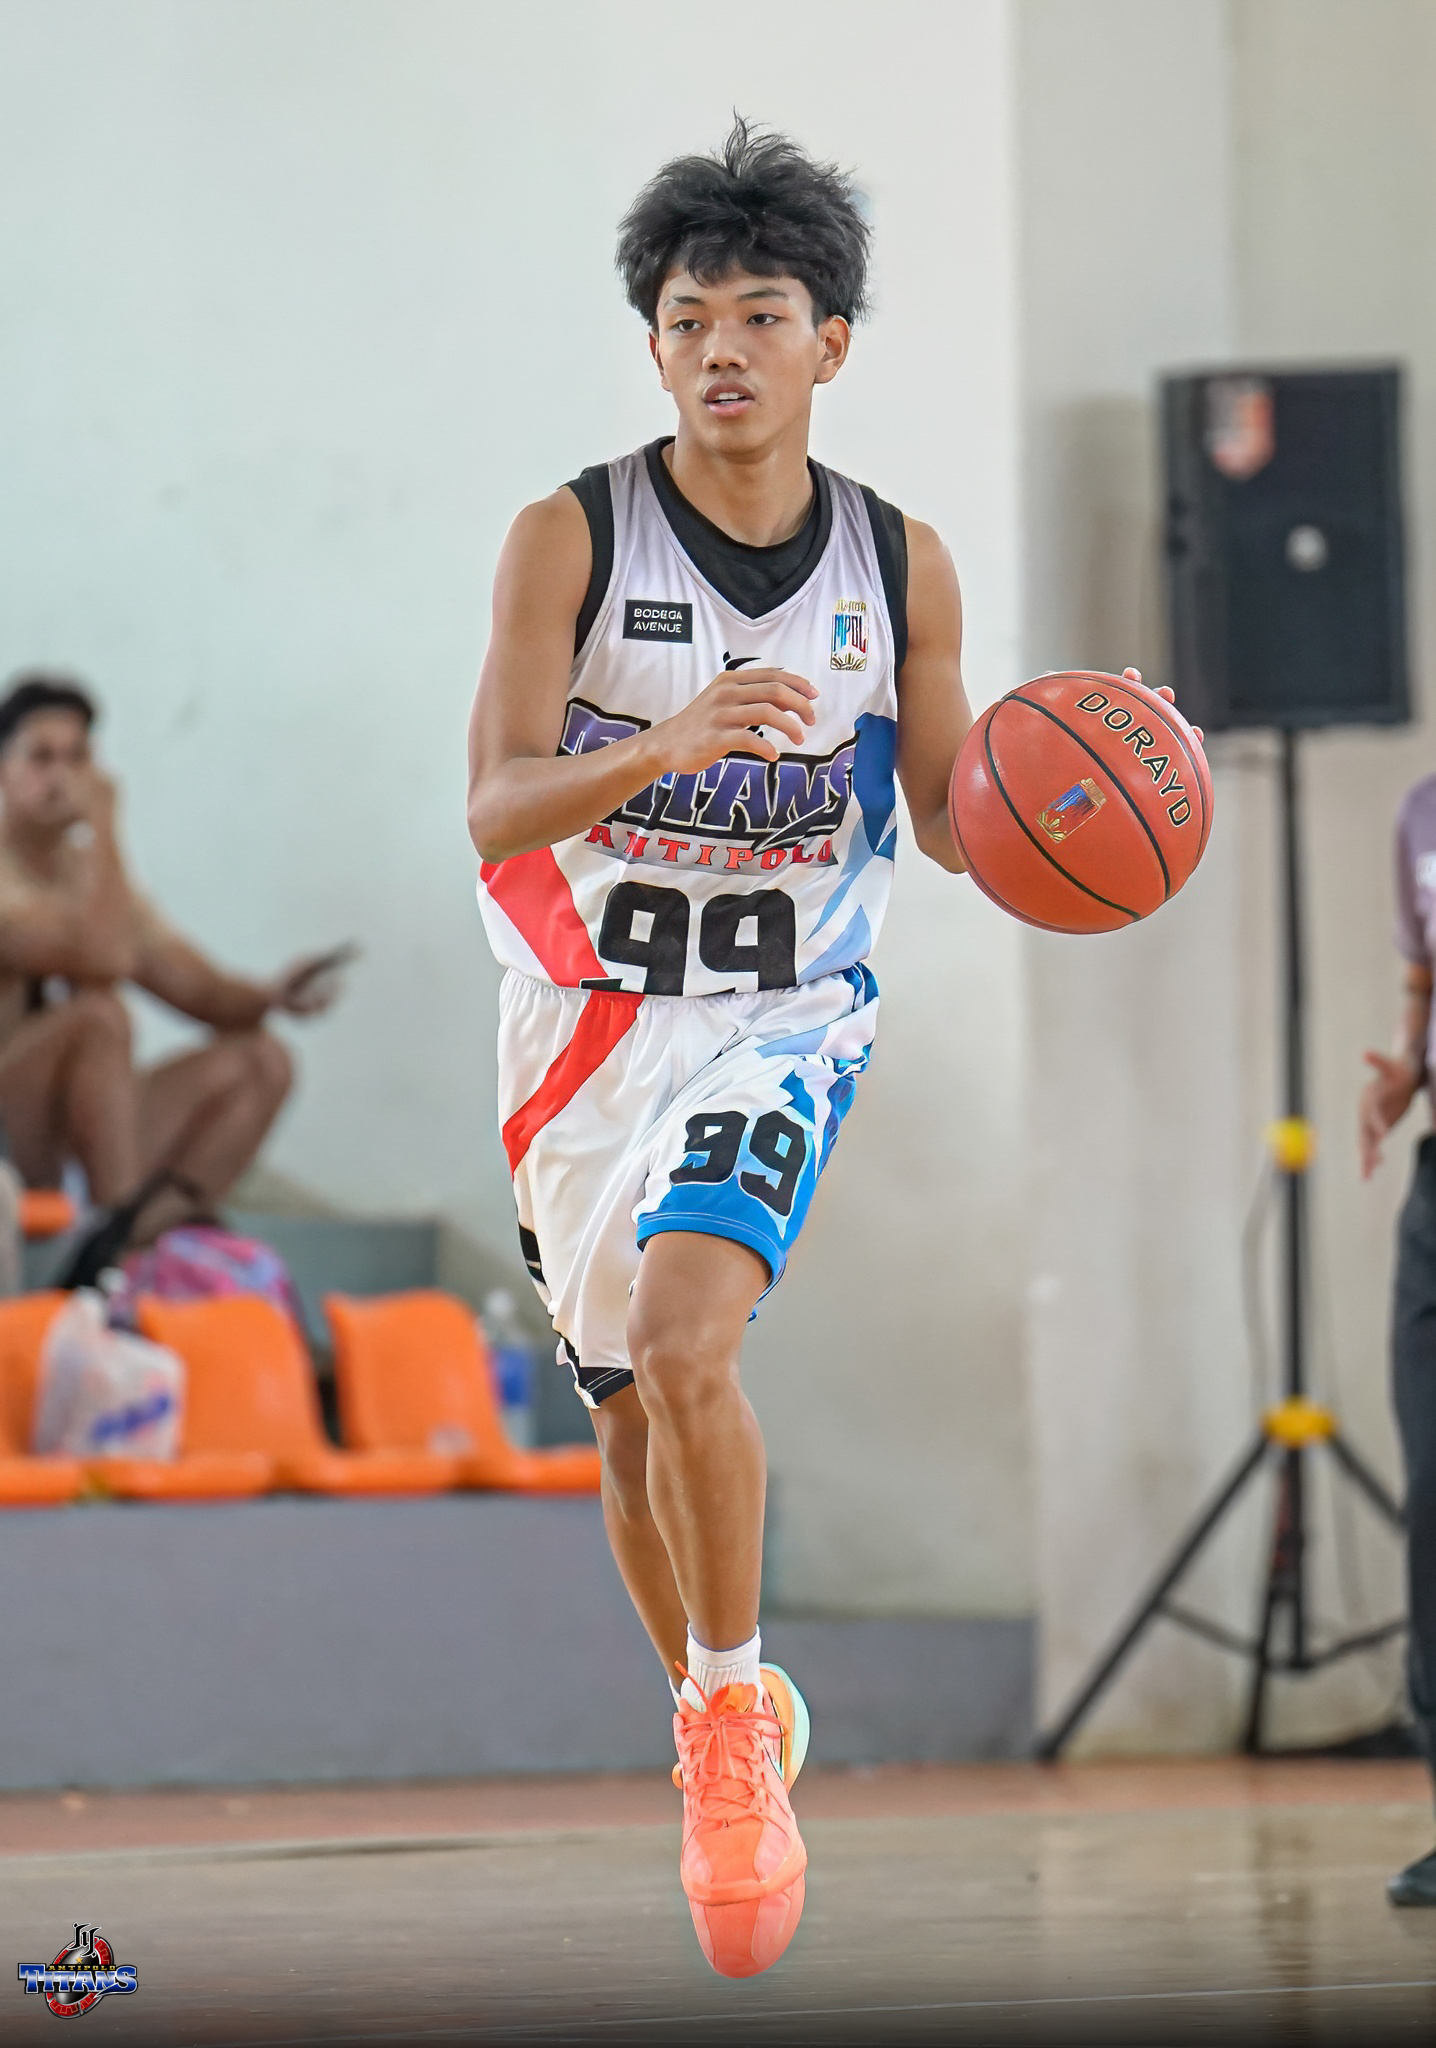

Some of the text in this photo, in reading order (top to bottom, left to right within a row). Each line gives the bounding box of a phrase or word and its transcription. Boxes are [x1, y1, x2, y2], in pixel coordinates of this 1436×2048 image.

[633, 607, 683, 620] BODEGA
[633, 621, 682, 633] AVENUE
[1075, 692, 1192, 827] DORAYD
[584, 823, 832, 870] ANTIPOLO
[580, 881, 799, 997] 99
[669, 1110, 806, 1217] 99
